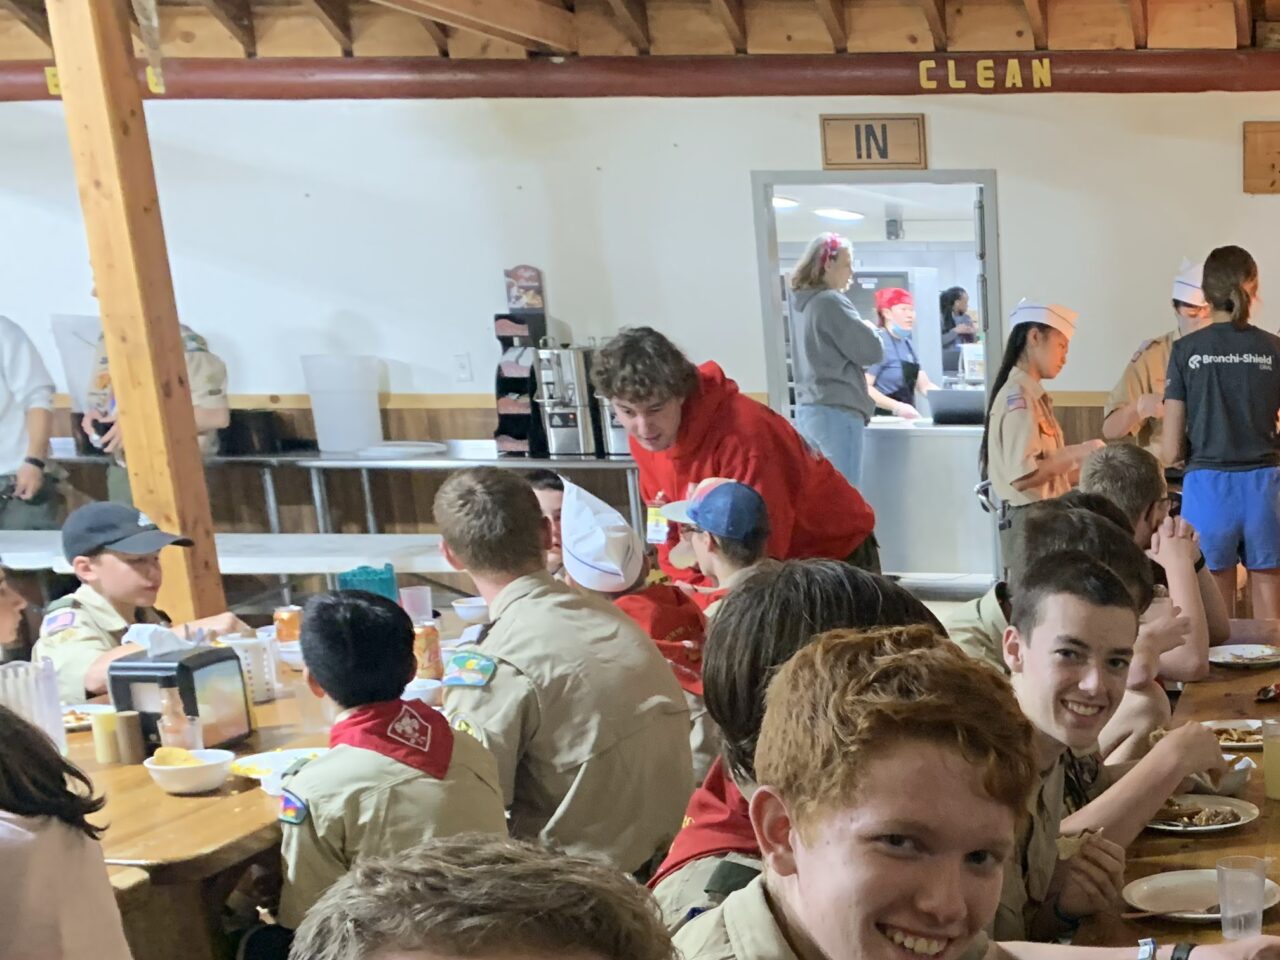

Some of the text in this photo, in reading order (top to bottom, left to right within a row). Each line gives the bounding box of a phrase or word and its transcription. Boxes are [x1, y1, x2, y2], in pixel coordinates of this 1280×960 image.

[918, 58, 1052, 89] CLEAN
[854, 123, 889, 160] IN
[1202, 353, 1273, 365] Bronchi-Shield
